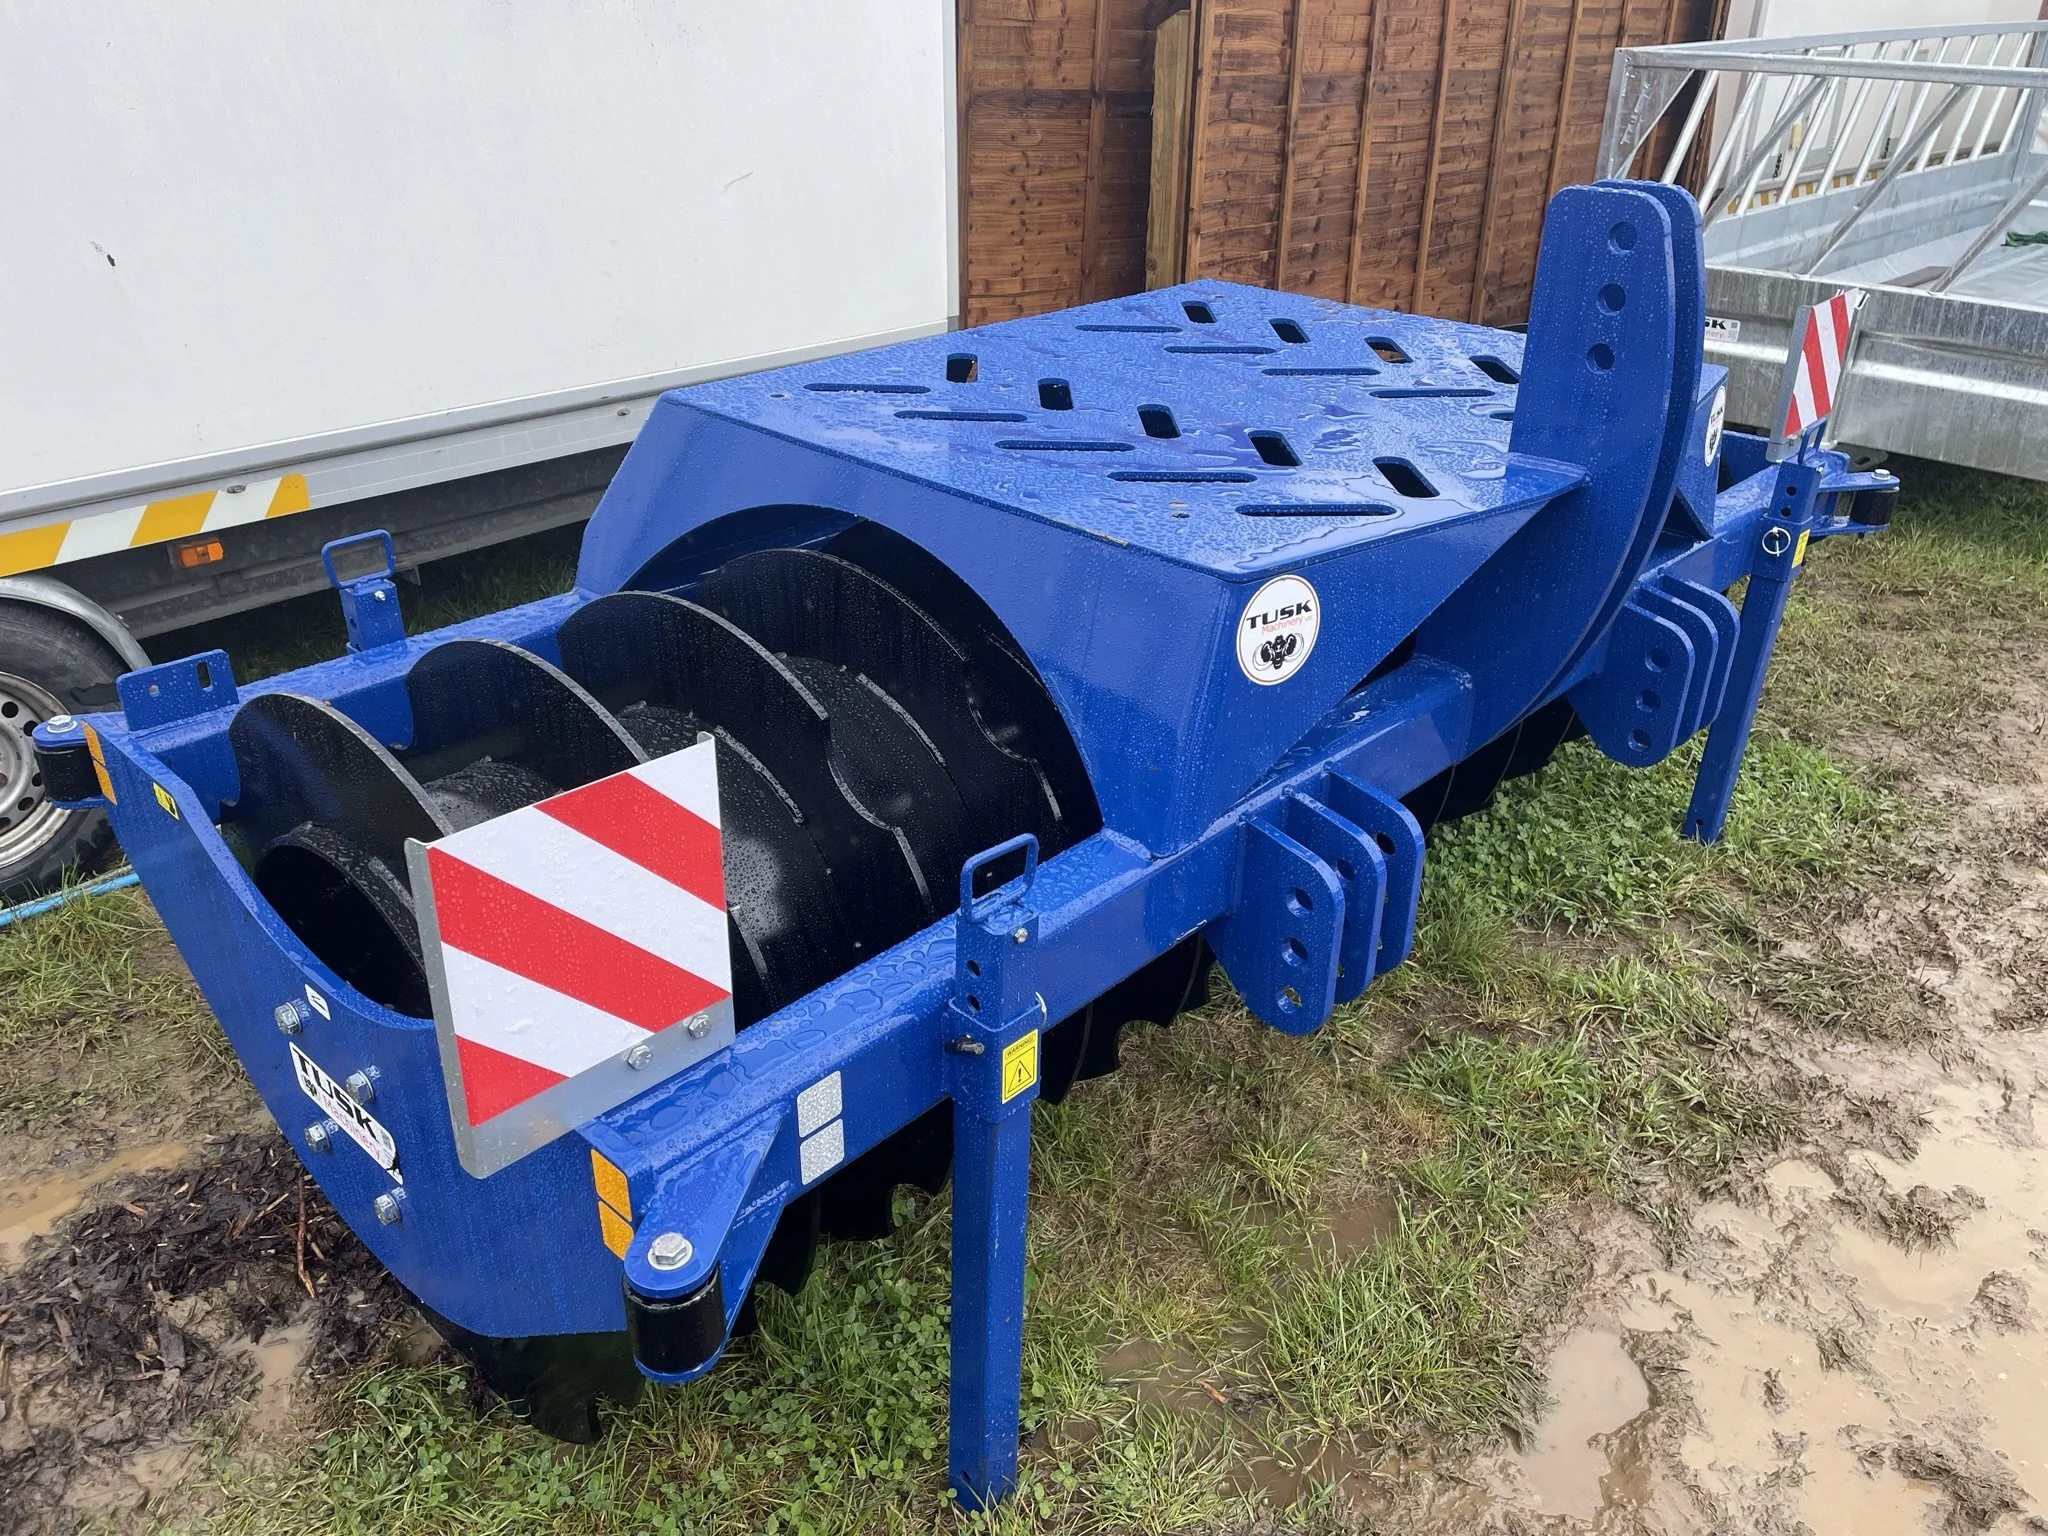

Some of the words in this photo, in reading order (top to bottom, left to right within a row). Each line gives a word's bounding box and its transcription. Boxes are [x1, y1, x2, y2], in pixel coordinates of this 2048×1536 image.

[1246, 600, 1312, 629] TUSK
[1261, 616, 1304, 634] Machinery
[293, 1047, 379, 1143] TUSK
[322, 1096, 380, 1160] Machinery
